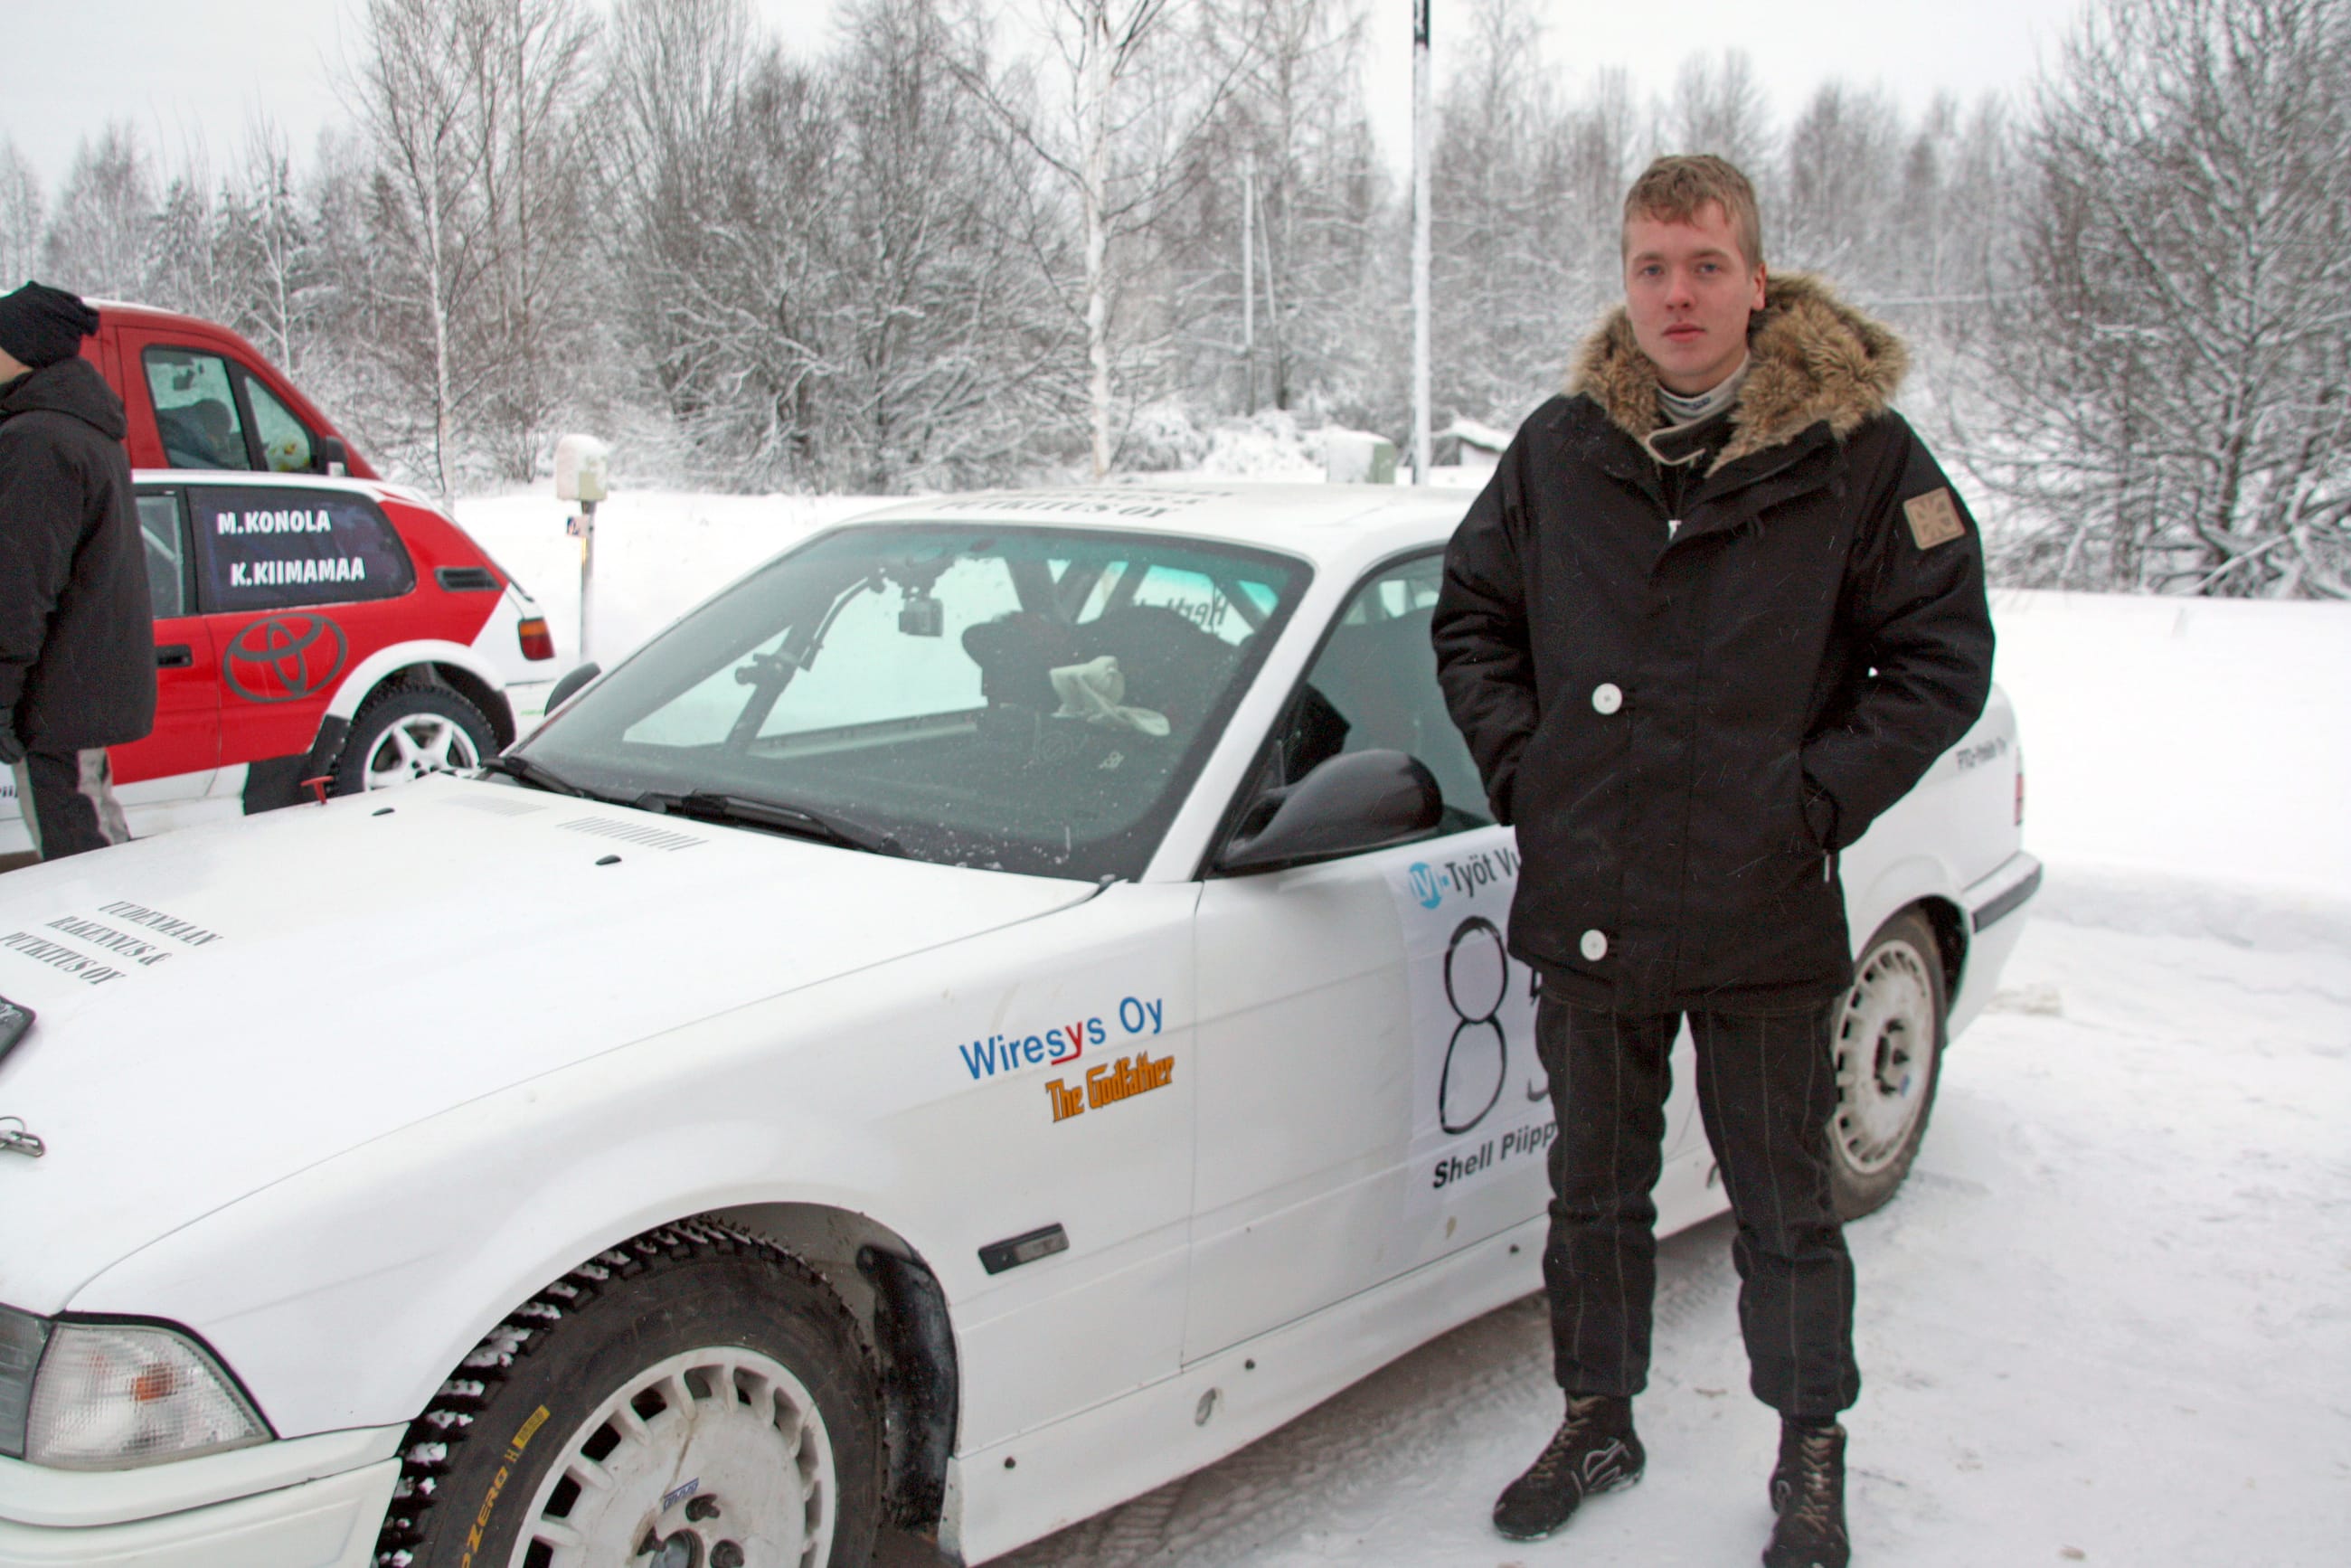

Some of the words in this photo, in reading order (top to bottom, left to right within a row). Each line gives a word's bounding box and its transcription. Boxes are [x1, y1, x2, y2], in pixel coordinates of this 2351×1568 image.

[217, 509, 331, 534] M.KONOLA
[231, 557, 366, 587] K.KIIMAMAA
[45, 915, 156, 958] RAKENNUS
[137, 950, 173, 966] &
[98, 901, 224, 947] UUDENMAAN
[0, 931, 98, 973] PUTKITUS
[80, 963, 127, 985] OY
[959, 1015, 1106, 1080] Wiresys
[1119, 997, 1164, 1034] Oy
[1044, 1078, 1085, 1123] The
[1085, 1051, 1176, 1109] Godfather
[1432, 1143, 1493, 1189] Shell
